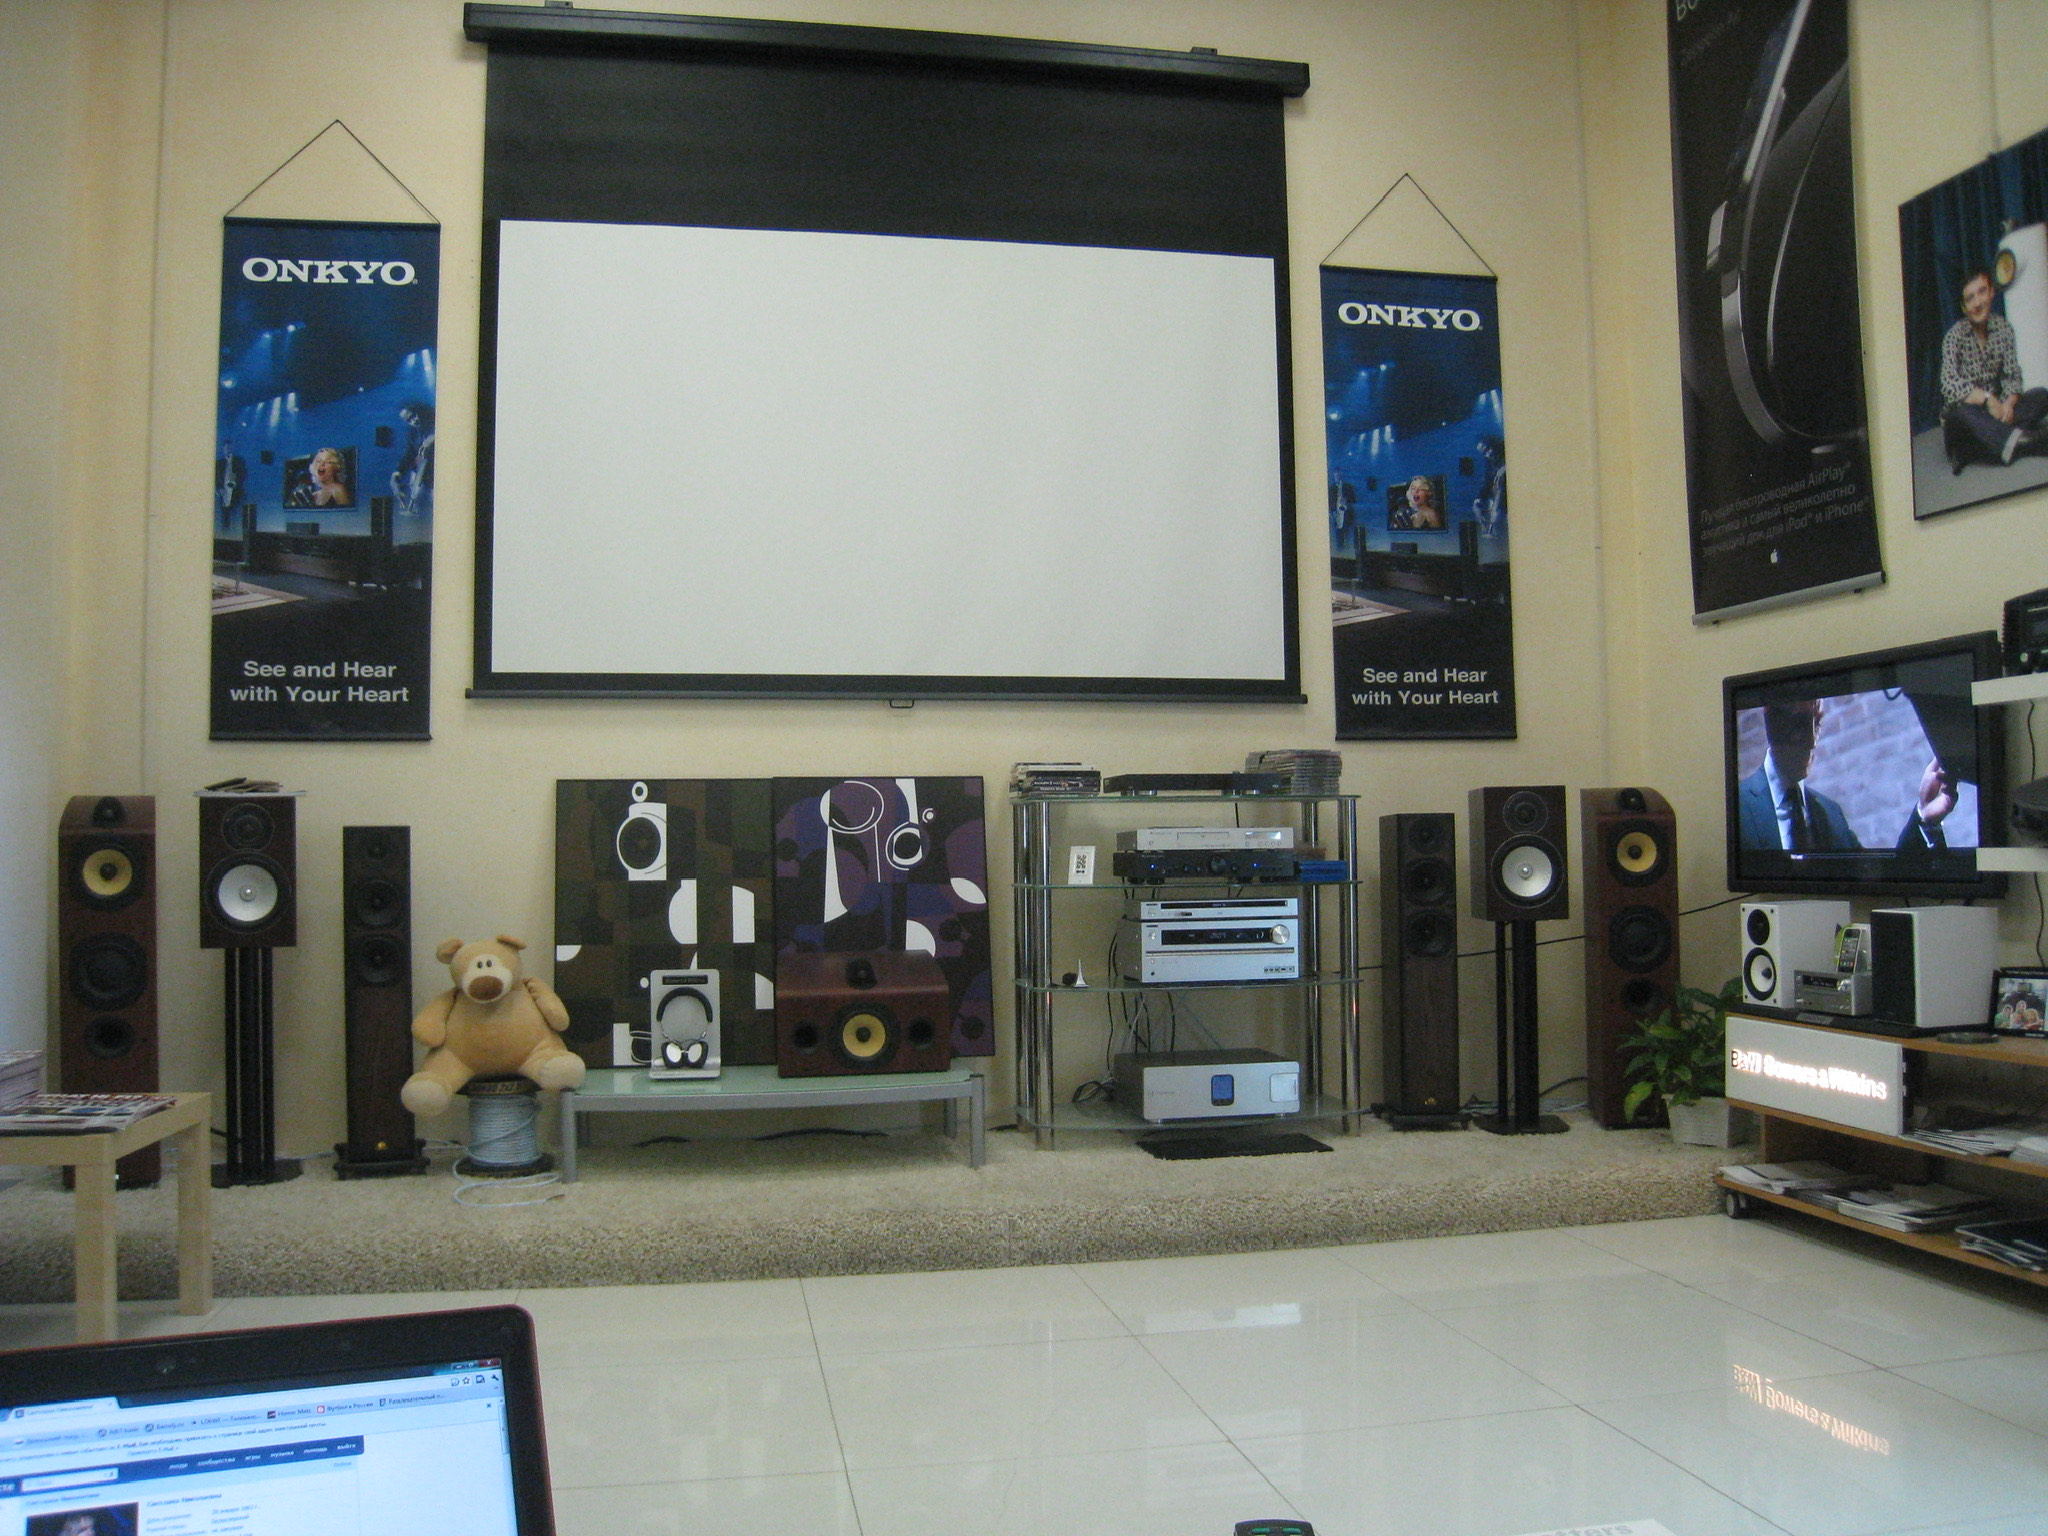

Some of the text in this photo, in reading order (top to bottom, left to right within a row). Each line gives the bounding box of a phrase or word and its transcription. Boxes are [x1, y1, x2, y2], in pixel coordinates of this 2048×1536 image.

[242, 257, 416, 286] ONKYO
[1338, 302, 1481, 332] ONKYO
[243, 660, 396, 678] See and Hear
[1363, 667, 1488, 683] See and Hear
[230, 685, 409, 703] with Your Heart
[1352, 689, 1499, 706] with Your Heart
